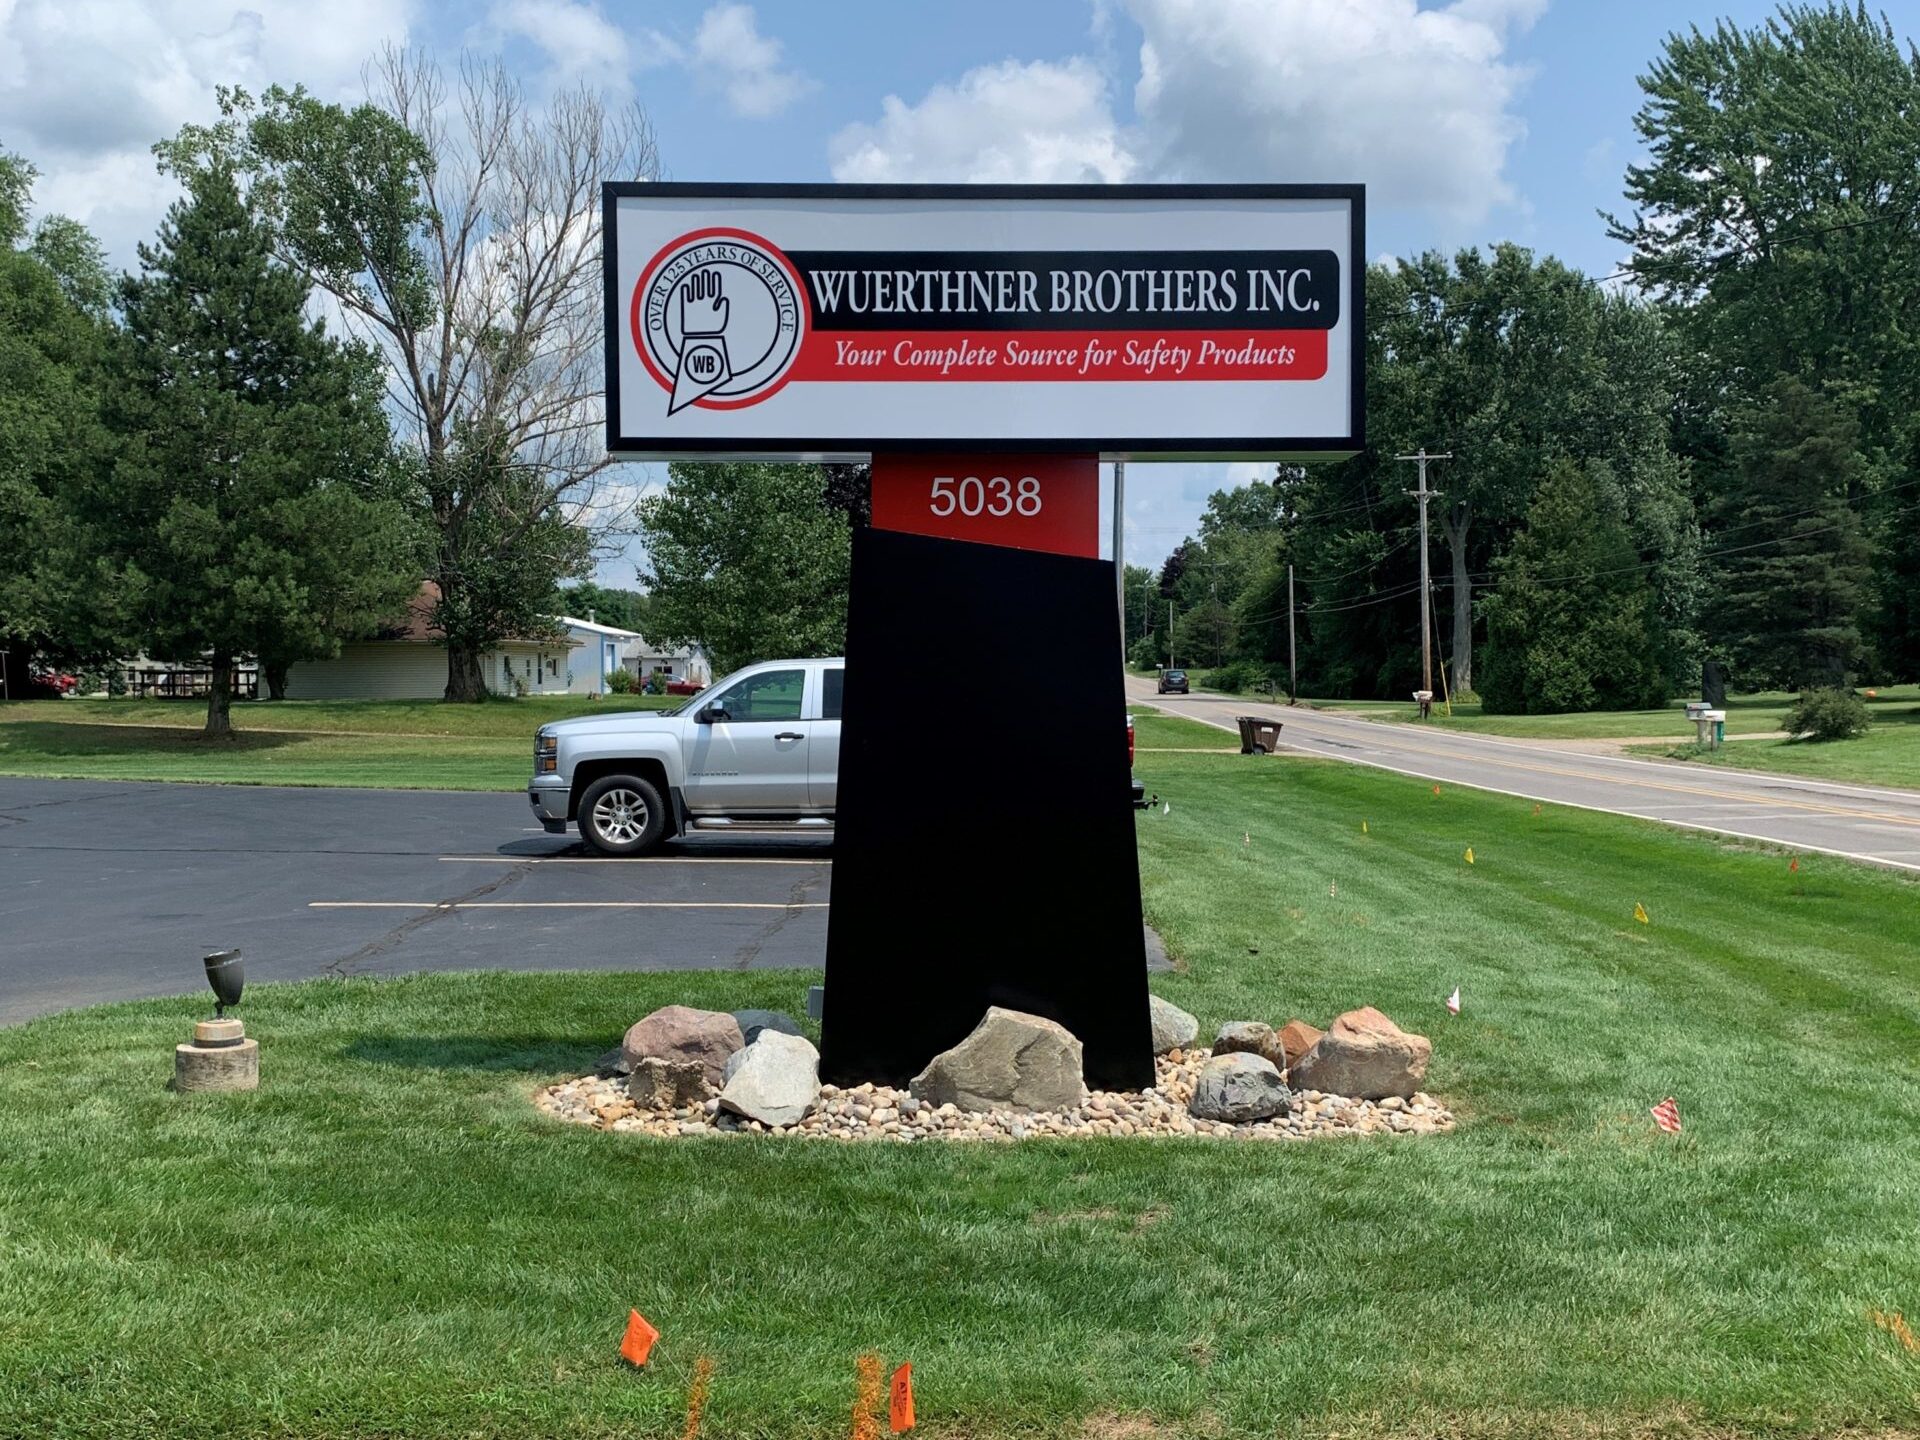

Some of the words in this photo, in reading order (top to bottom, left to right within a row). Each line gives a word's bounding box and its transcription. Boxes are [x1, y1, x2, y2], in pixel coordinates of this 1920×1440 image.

[650, 284, 668, 331] OVER
[663, 261, 686, 283] 125
[683, 246, 737, 267] YEARS
[740, 251, 761, 268] OF
[758, 263, 794, 332] SERVICE
[808, 269, 1041, 313] WUERTHNER
[1049, 268, 1237, 313] BROTHERS
[1246, 268, 1321, 312] INC.
[692, 355, 715, 373] WB
[834, 340, 887, 367] Your
[893, 339, 997, 374] Complete
[1003, 340, 1077, 366] Source
[1078, 338, 1117, 375] for
[1122, 338, 1192, 375] Safety
[1196, 338, 1297, 366] Products
[929, 476, 1042, 517] 5038
